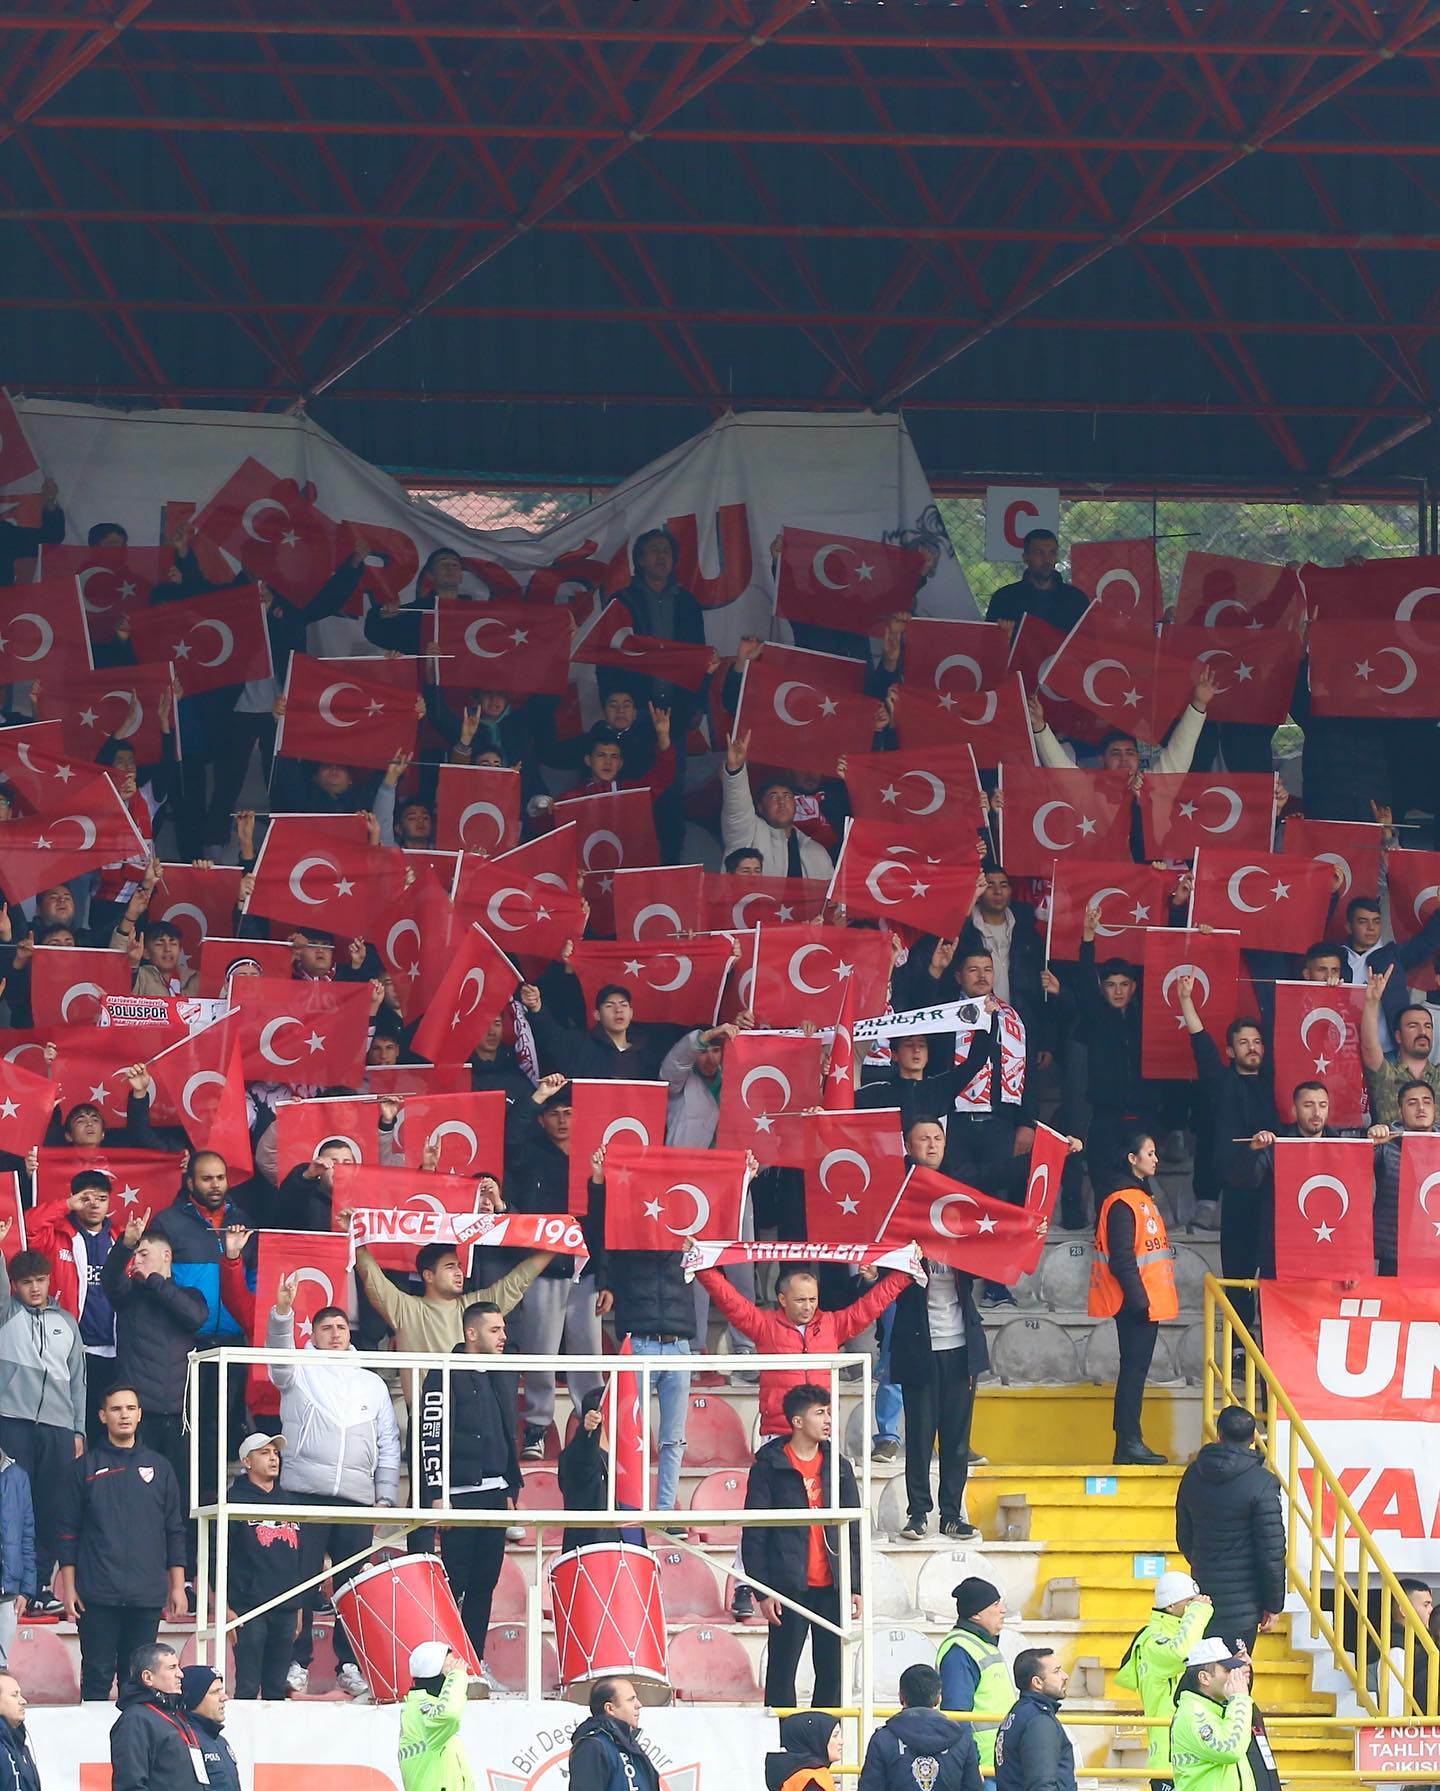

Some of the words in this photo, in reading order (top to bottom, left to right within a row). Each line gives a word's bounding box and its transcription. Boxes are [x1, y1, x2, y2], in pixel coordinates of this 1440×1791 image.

[1004, 500, 1040, 549] C
[108, 1005, 166, 1018] BOLUSPOR
[353, 1211, 437, 1239] SINCE
[533, 1217, 586, 1248] 196
[694, 1399, 706, 1408] 16
[725, 1480, 737, 1489] 15
[1096, 1478, 1107, 1494] F
[1298, 1468, 1440, 1539] YA
[668, 1554, 680, 1563] 15
[1143, 1560, 1156, 1576] E
[505, 1630, 517, 1639] 12
[700, 1631, 711, 1640] 14
[1374, 1727, 1385, 1738] 2
[512, 1745, 538, 1774] Bir
[537, 1719, 578, 1752] Dest
[1369, 1741, 1440, 1757] TAHLİY
